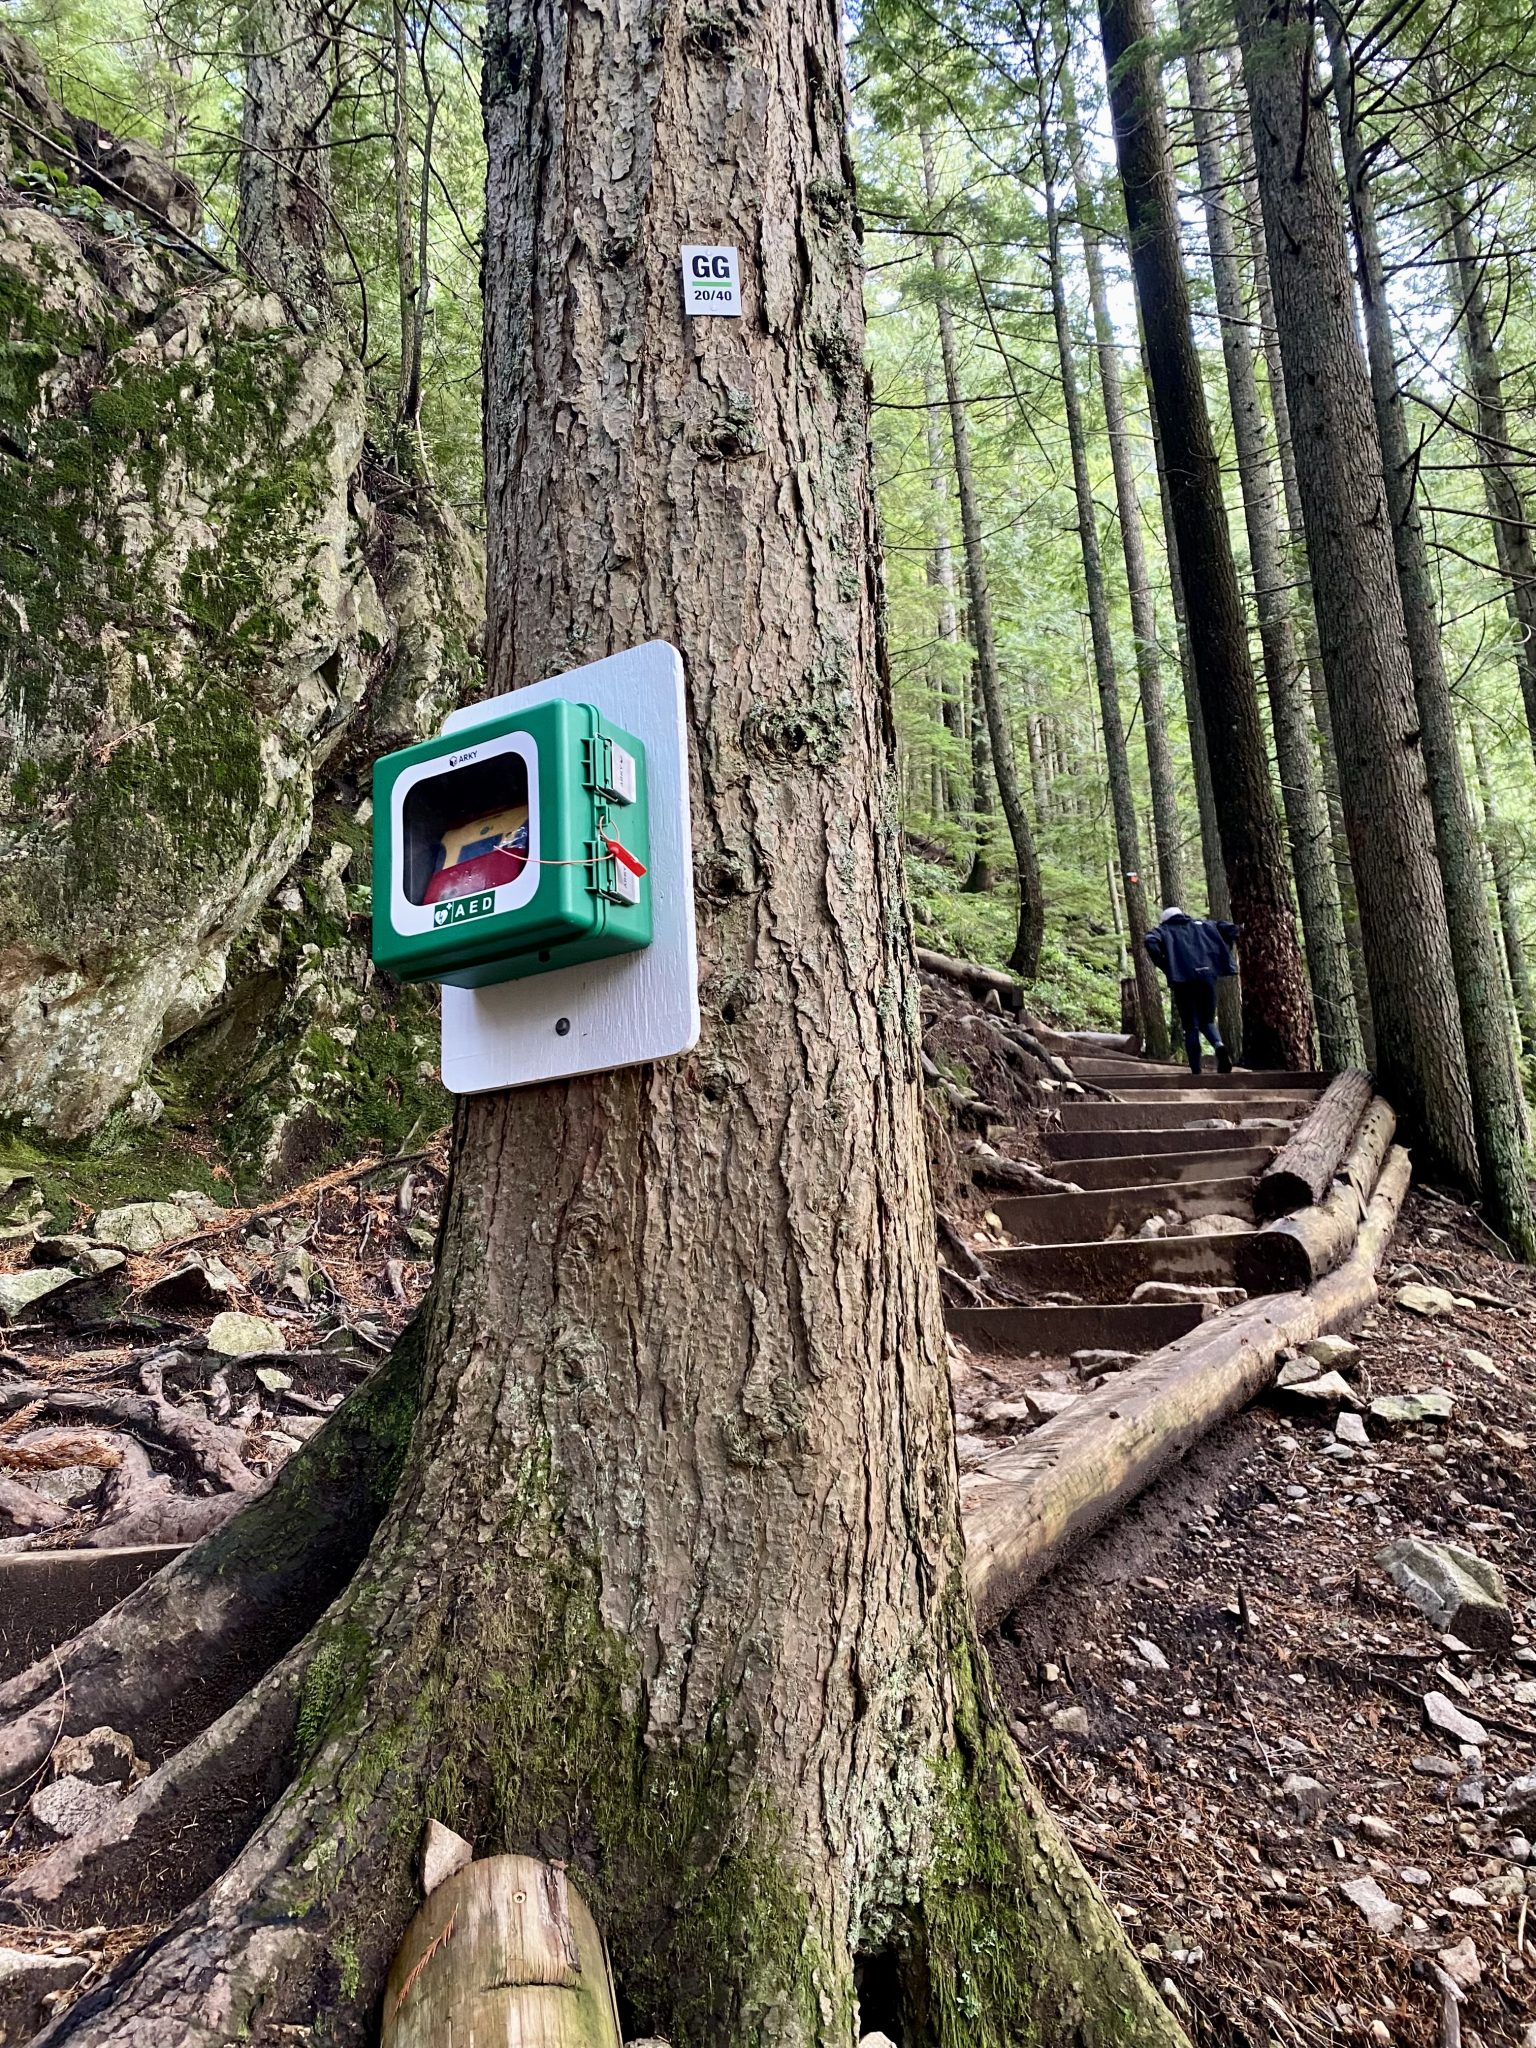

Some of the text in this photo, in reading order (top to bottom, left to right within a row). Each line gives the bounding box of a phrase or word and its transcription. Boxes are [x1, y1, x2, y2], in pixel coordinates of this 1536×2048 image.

[692, 255, 730, 278] GG
[694, 290, 732, 301] 20/40
[459, 750, 478, 763] ARKY
[455, 897, 492, 918] AED
